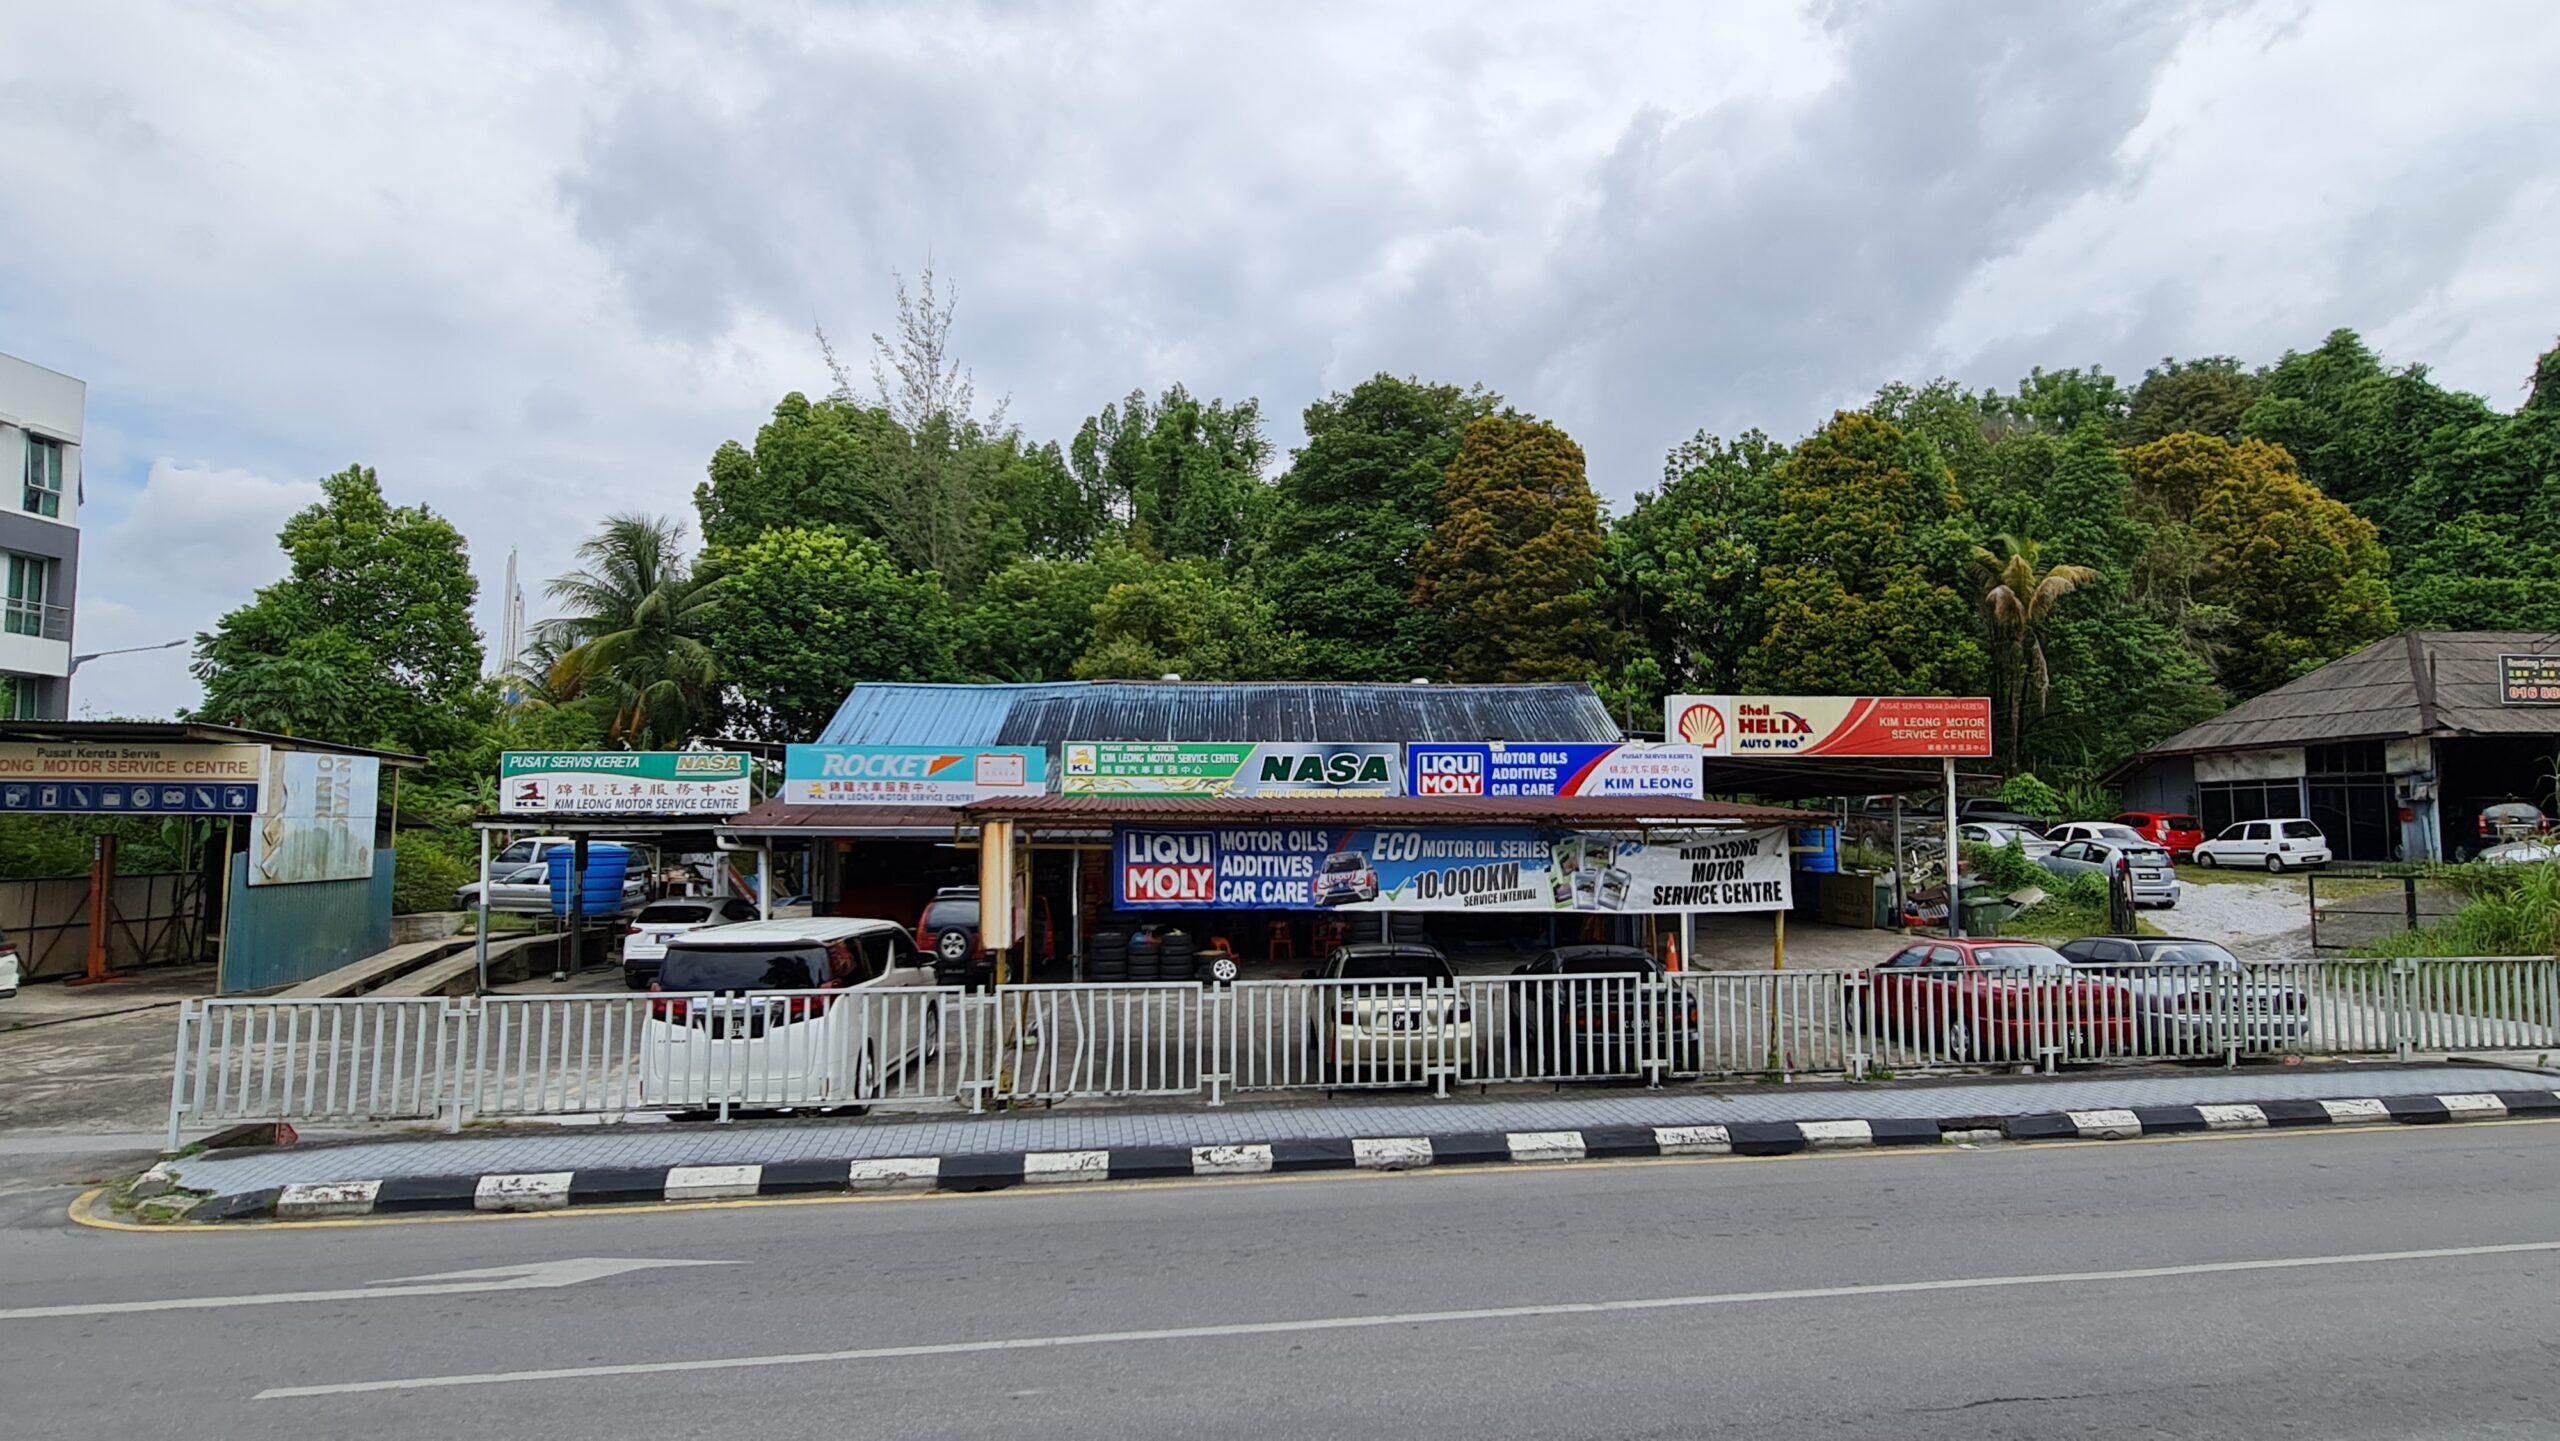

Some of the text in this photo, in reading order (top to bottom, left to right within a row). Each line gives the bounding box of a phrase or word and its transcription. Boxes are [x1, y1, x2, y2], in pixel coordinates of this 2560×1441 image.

[1739, 704, 1770, 716] Shell
[1738, 713, 1813, 734] HELIX
[1879, 717, 1985, 727] KIM LEONG MOTOR
[1891, 730, 1985, 739] SERVICE CENTRE
[1740, 739, 1798, 748] AUTO PRO
[37, 747, 160, 759] Pusat Kereta Servis
[1101, 754, 1239, 764] KIM LEONG MOTOR SERVICE CENTRE
[1492, 752, 1568, 764] MOTOR OILS
[43, 760, 102, 772] MOTOR
[107, 761, 176, 773] SERVICE
[183, 761, 248, 774] CENTRE
[509, 756, 640, 768] PUSAT SERVIS KERETA
[675, 755, 741, 770] NASA
[822, 753, 964, 777] ROCKET
[1072, 764, 1093, 772] KL
[1259, 753, 1391, 785] NASA
[1422, 756, 1479, 774] LIQUI
[1492, 768, 1557, 780] ADDITIVES
[1422, 775, 1480, 793] MOLY
[1492, 784, 1554, 796] CAR CARE
[1605, 778, 1693, 789] KIM LEONG
[554, 799, 739, 809] KIM LEONG MOTOR SERVICE CENTRE
[847, 793, 875, 801] LEONG
[878, 793, 907, 801] MOTOR
[911, 793, 942, 801] SERVICE
[945, 793, 974, 801] CENTRE
[1220, 831, 1328, 851] MOTOR OILS
[1372, 832, 1550, 862] ECO MOTOR OIL SERIES
[1129, 834, 1210, 864] LIQUI
[1220, 856, 1313, 877] ADDITIVES
[1691, 860, 1744, 883] MOTOR
[1129, 867, 1213, 898] MOLY
[1414, 862, 1519, 900] 10,000KM
[1220, 882, 1308, 903] CAR CARE
[1463, 888, 1537, 907] SERVICE INTERVAL
[1653, 881, 1783, 906] SERVICE CENTRE
